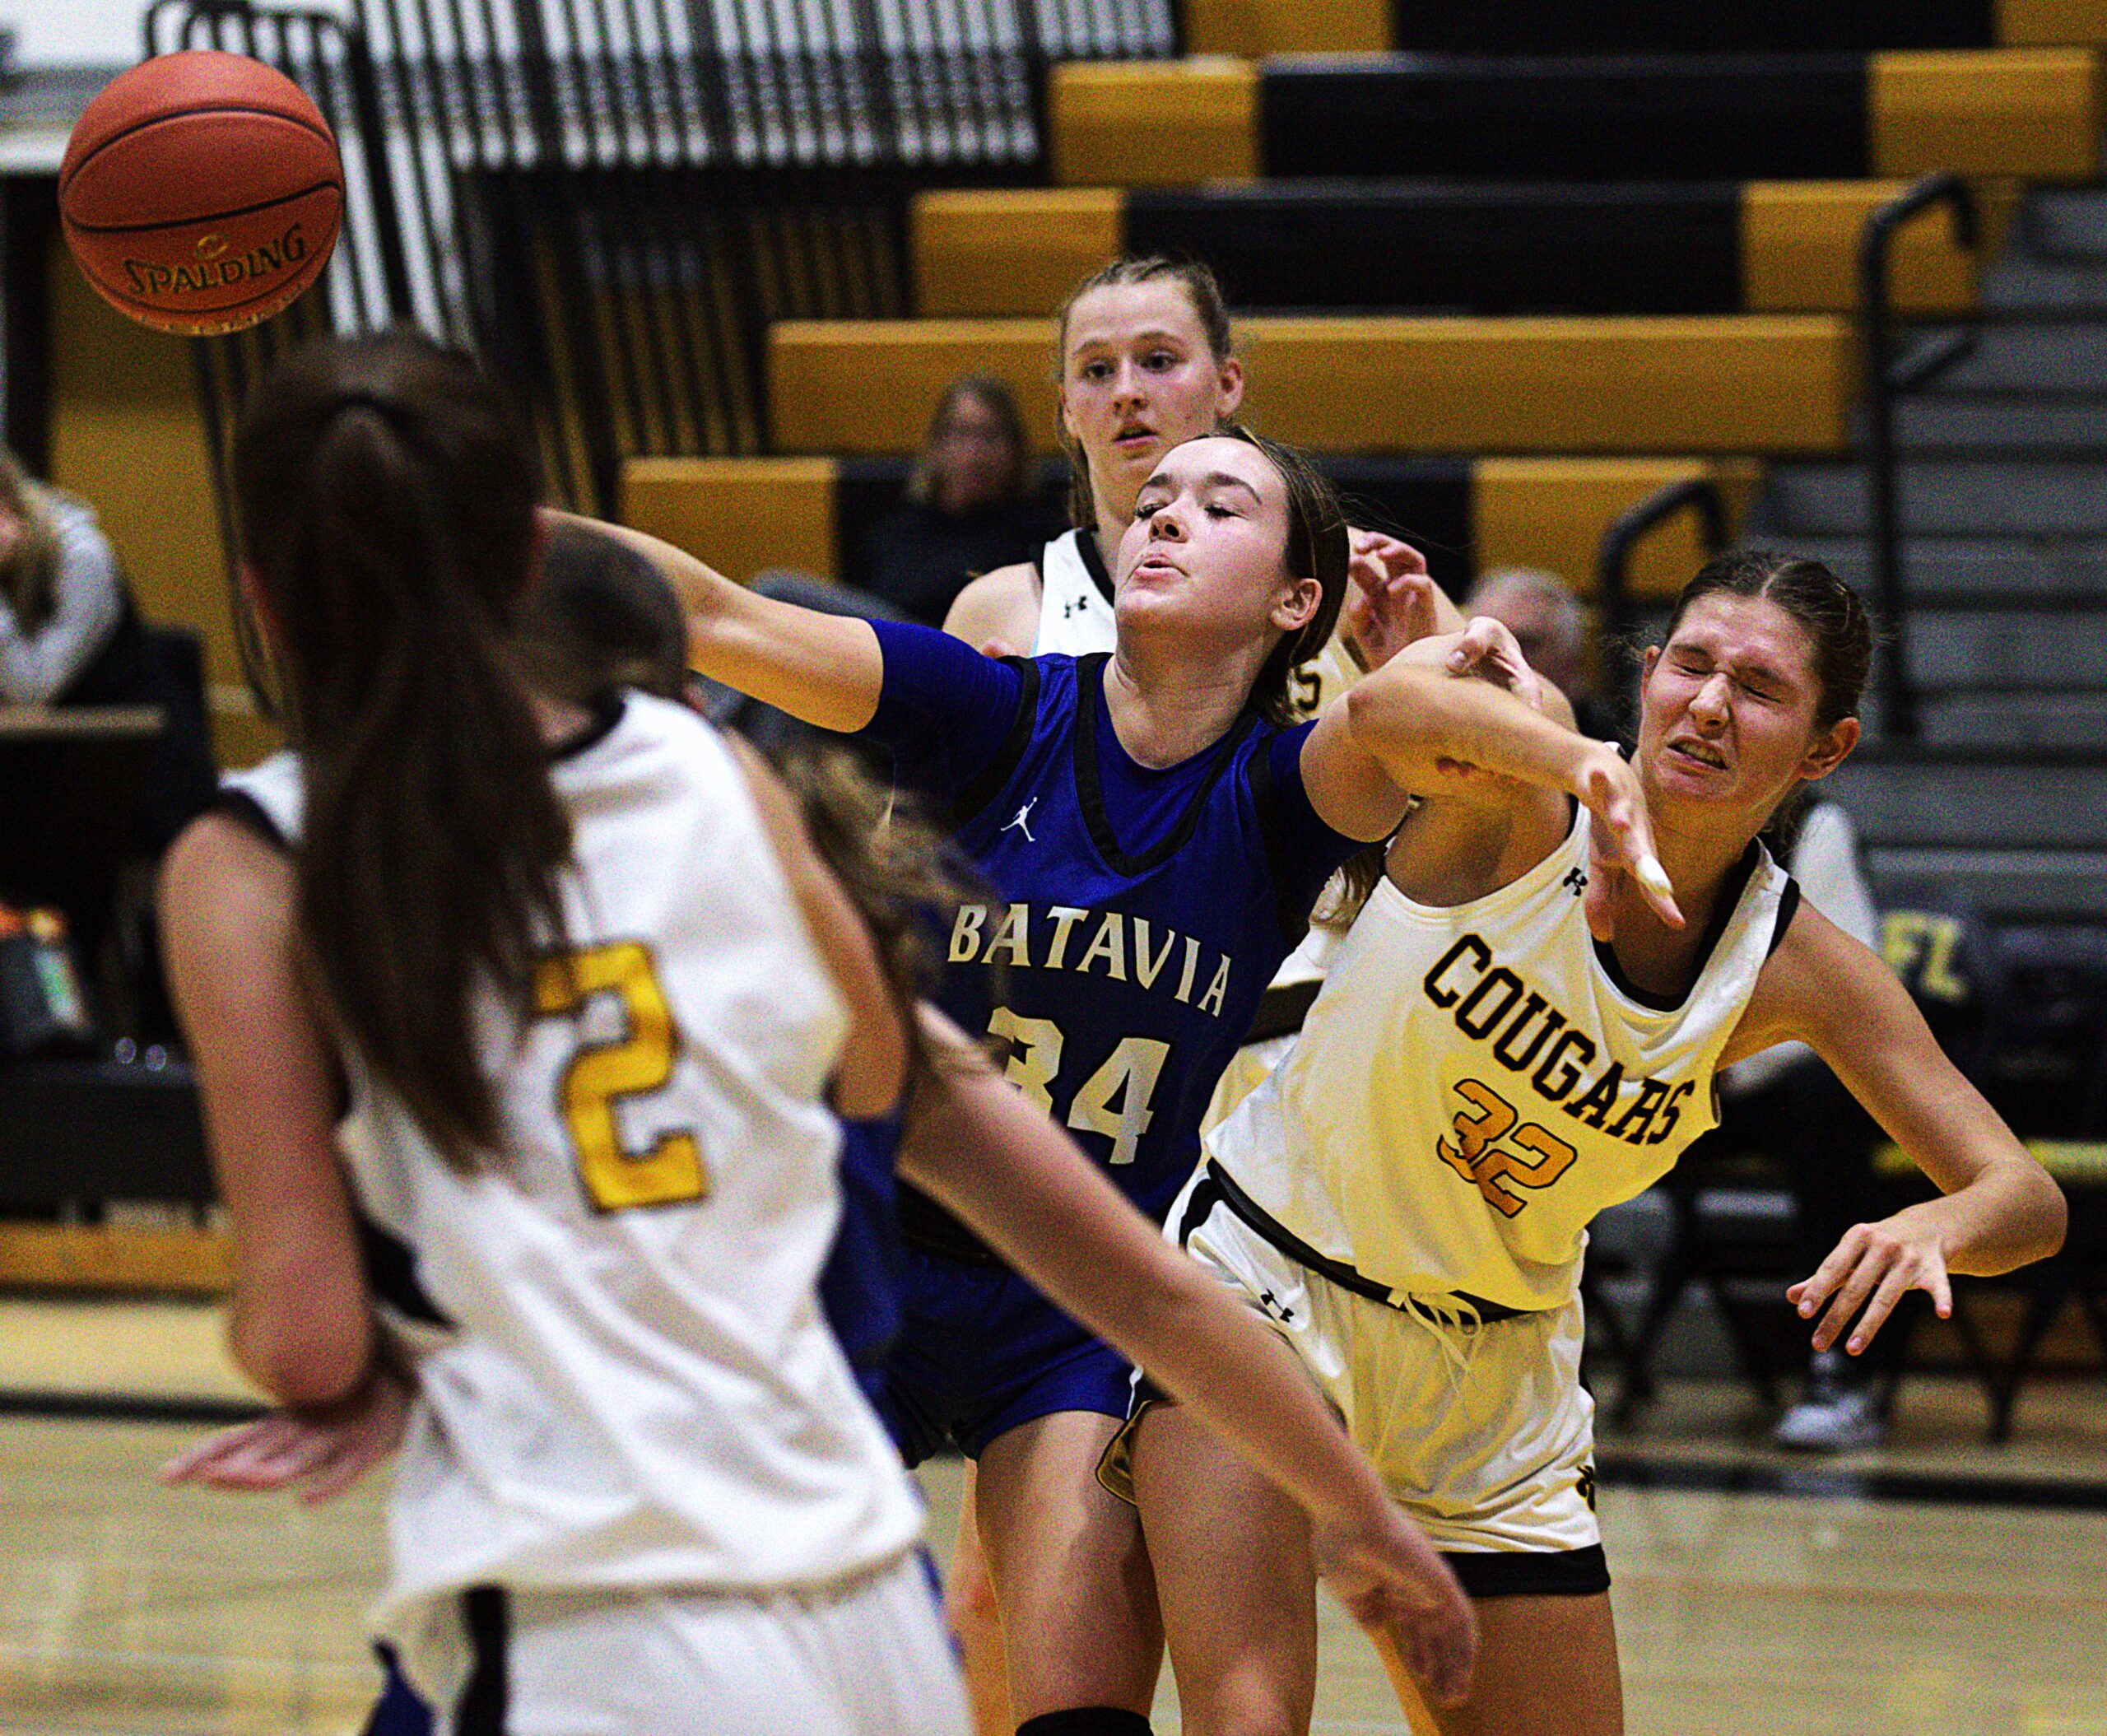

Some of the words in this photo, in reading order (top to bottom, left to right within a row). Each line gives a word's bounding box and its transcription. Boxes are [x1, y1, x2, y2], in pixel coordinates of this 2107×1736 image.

[123, 223, 305, 294] SPALDING
[947, 903, 1231, 1017] BATAVIA
[535, 938, 711, 1218] 2
[987, 1006, 1171, 1165] 34
[1424, 933, 1695, 1146] COUGARS
[1436, 1078, 1578, 1219] 32
